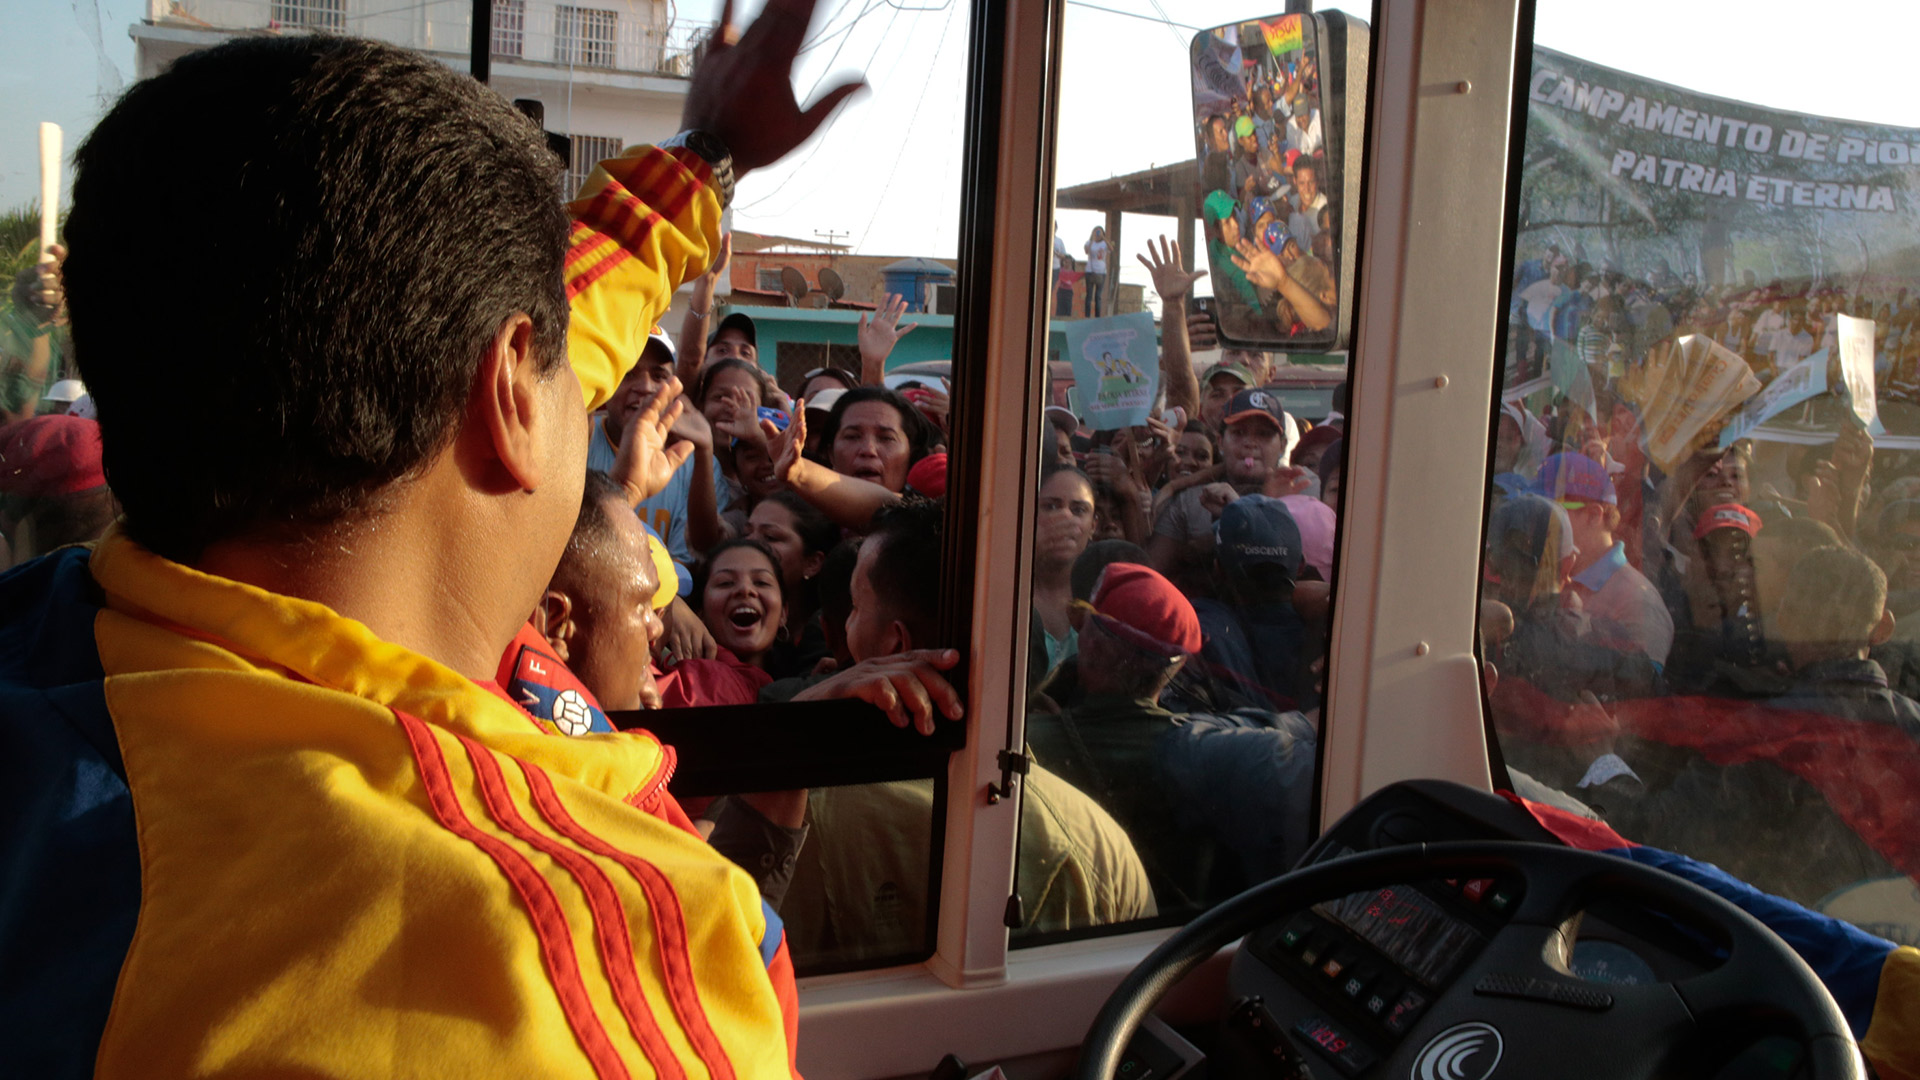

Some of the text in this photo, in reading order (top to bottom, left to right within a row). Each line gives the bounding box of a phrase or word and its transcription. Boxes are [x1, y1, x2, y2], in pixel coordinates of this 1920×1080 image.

[1529, 68, 1774, 154] CAMPAMENTO
[1777, 128, 1832, 163] DE
[1610, 147, 1896, 212] PATRIA ETERNA
[1244, 544, 1289, 557] DISCENTE
